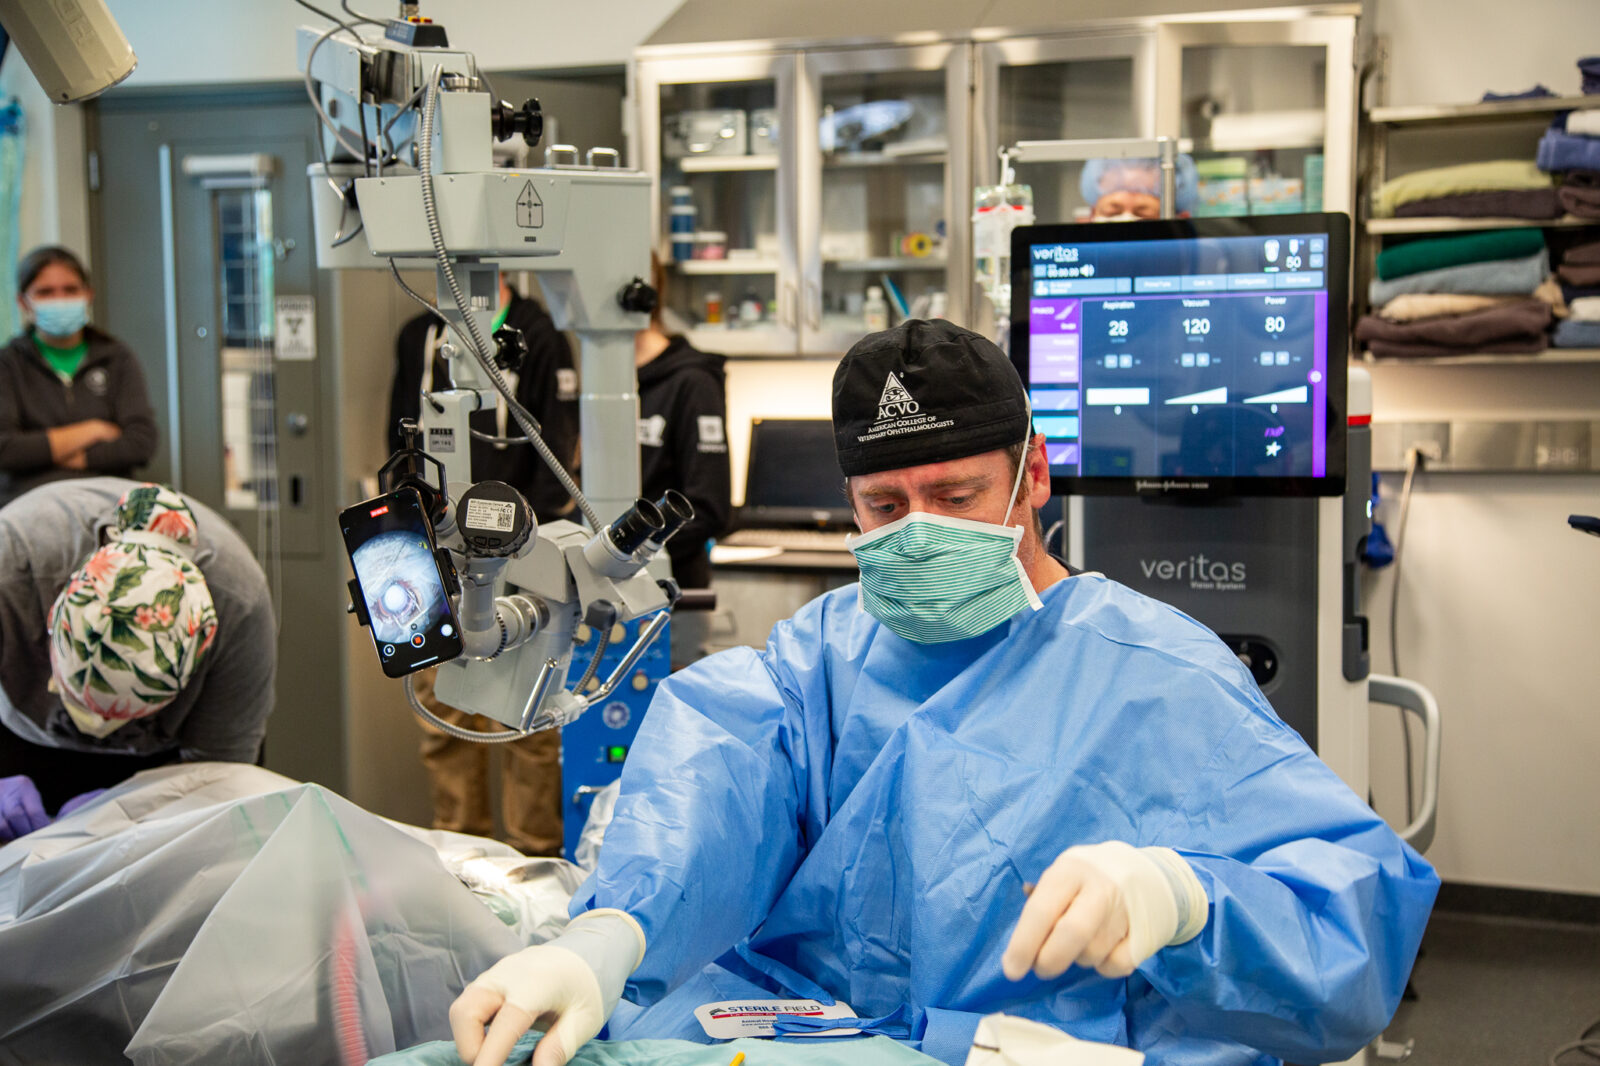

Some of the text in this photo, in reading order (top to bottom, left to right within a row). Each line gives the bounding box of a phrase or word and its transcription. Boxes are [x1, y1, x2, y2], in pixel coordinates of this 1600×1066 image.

[1033, 246, 1079, 260] veritas
[1286, 256, 1301, 268] 50
[1264, 296, 1287, 305] Power
[1108, 320, 1128, 336] 28
[1182, 318, 1211, 335] 120
[1264, 316, 1285, 332] 80
[877, 401, 919, 420] ACVO
[896, 416, 927, 428] COLLEGE
[927, 415, 937, 423] OF
[1140, 553, 1247, 582] veritas
[727, 1004, 821, 1013] STERILE FIELD
